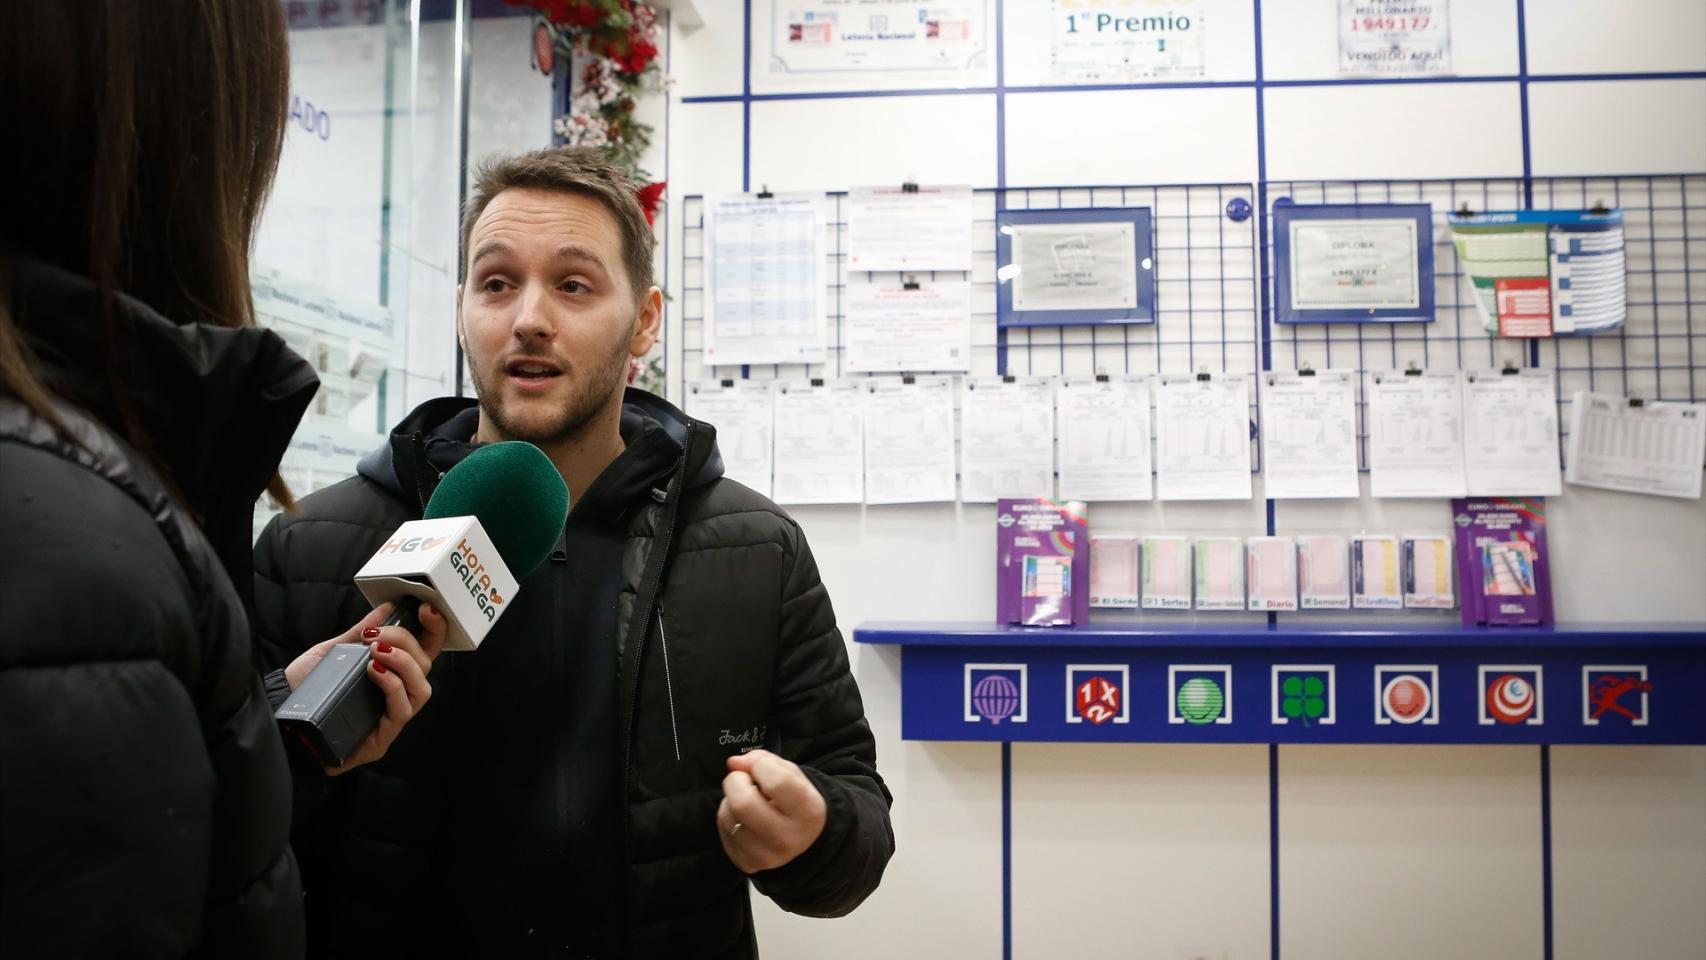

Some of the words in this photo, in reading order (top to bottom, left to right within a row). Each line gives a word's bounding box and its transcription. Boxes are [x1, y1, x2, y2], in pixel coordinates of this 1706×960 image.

[1097, 11, 1191, 32] Premio
[1331, 241, 1376, 250] DIPLOMA
[450, 551, 496, 622] GALEGA
[1266, 600, 1294, 608] Diario
[719, 729, 750, 745] Jack
